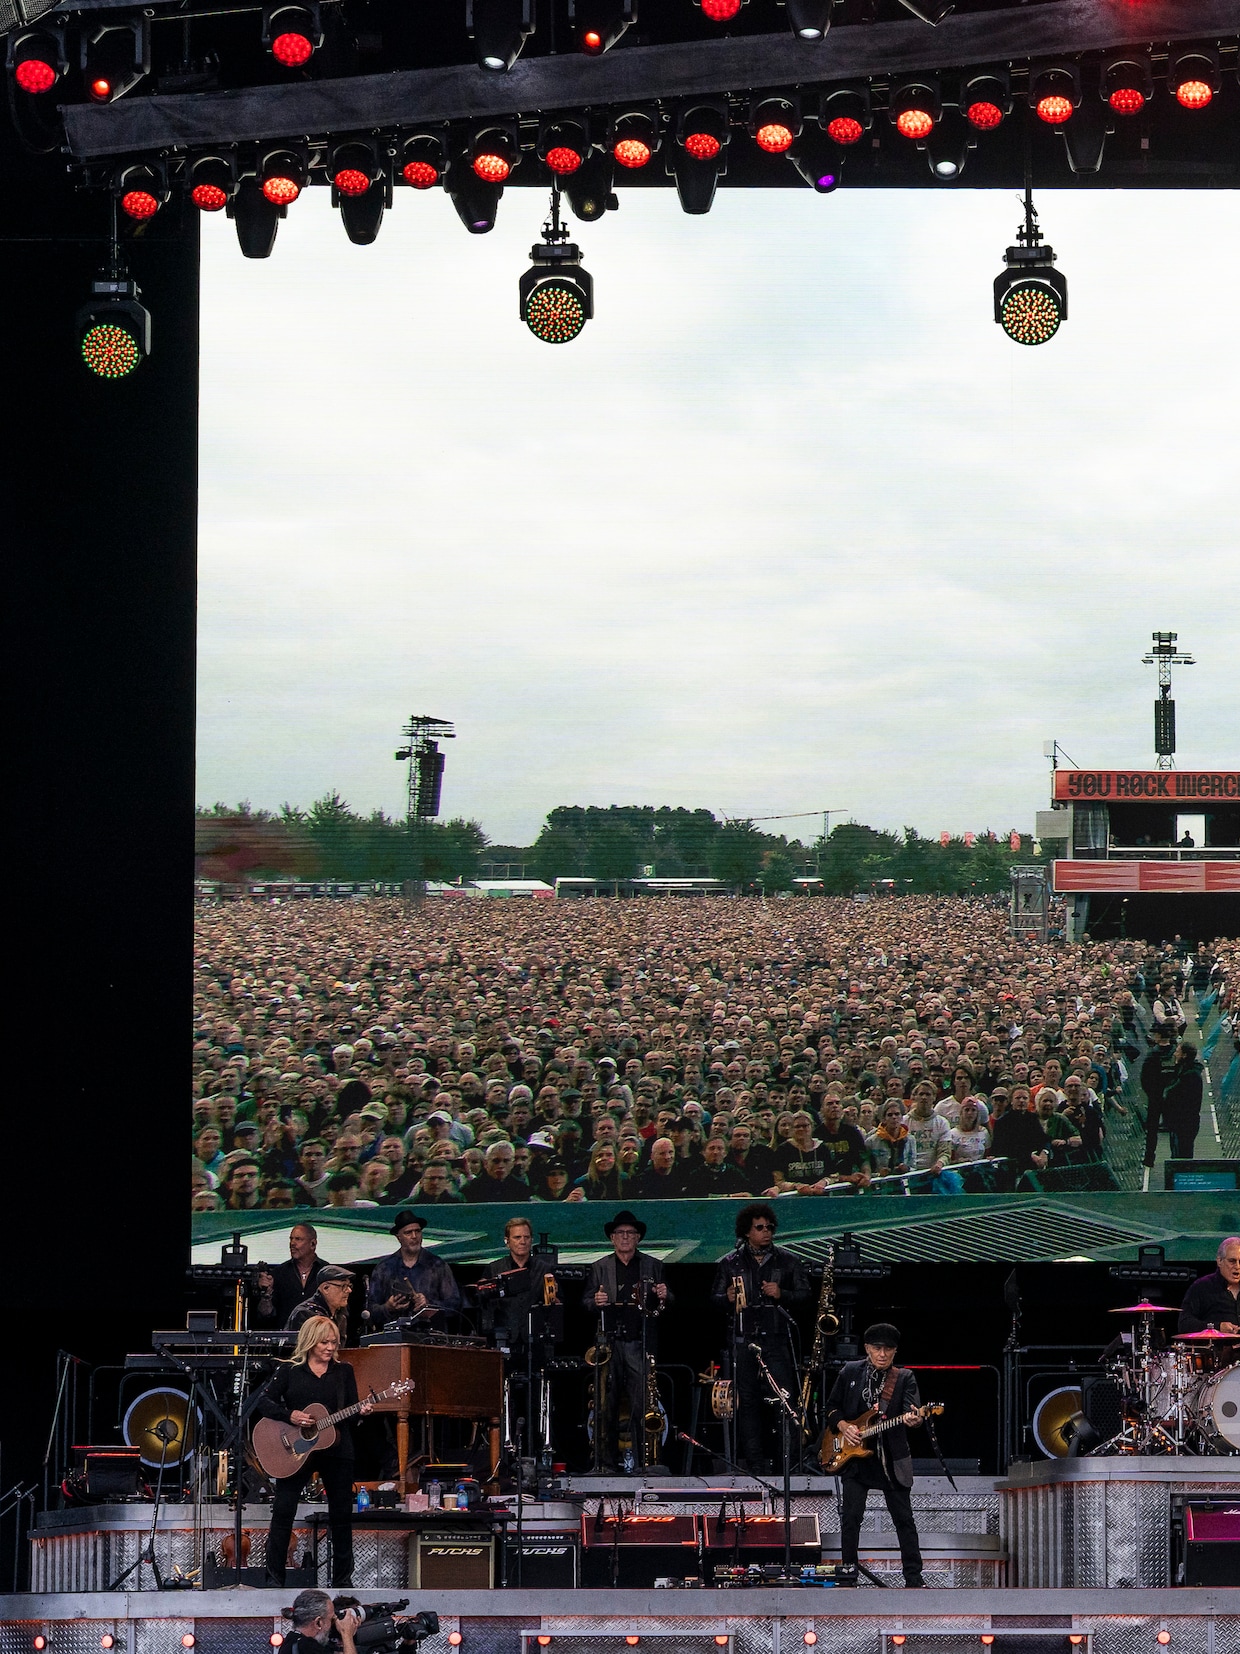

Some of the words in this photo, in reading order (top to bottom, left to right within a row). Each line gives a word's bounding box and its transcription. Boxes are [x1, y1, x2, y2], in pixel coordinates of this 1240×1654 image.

[1068, 774, 1111, 797] YOU
[1116, 774, 1171, 797] ROCK
[427, 1547, 483, 1556] FUCHS
